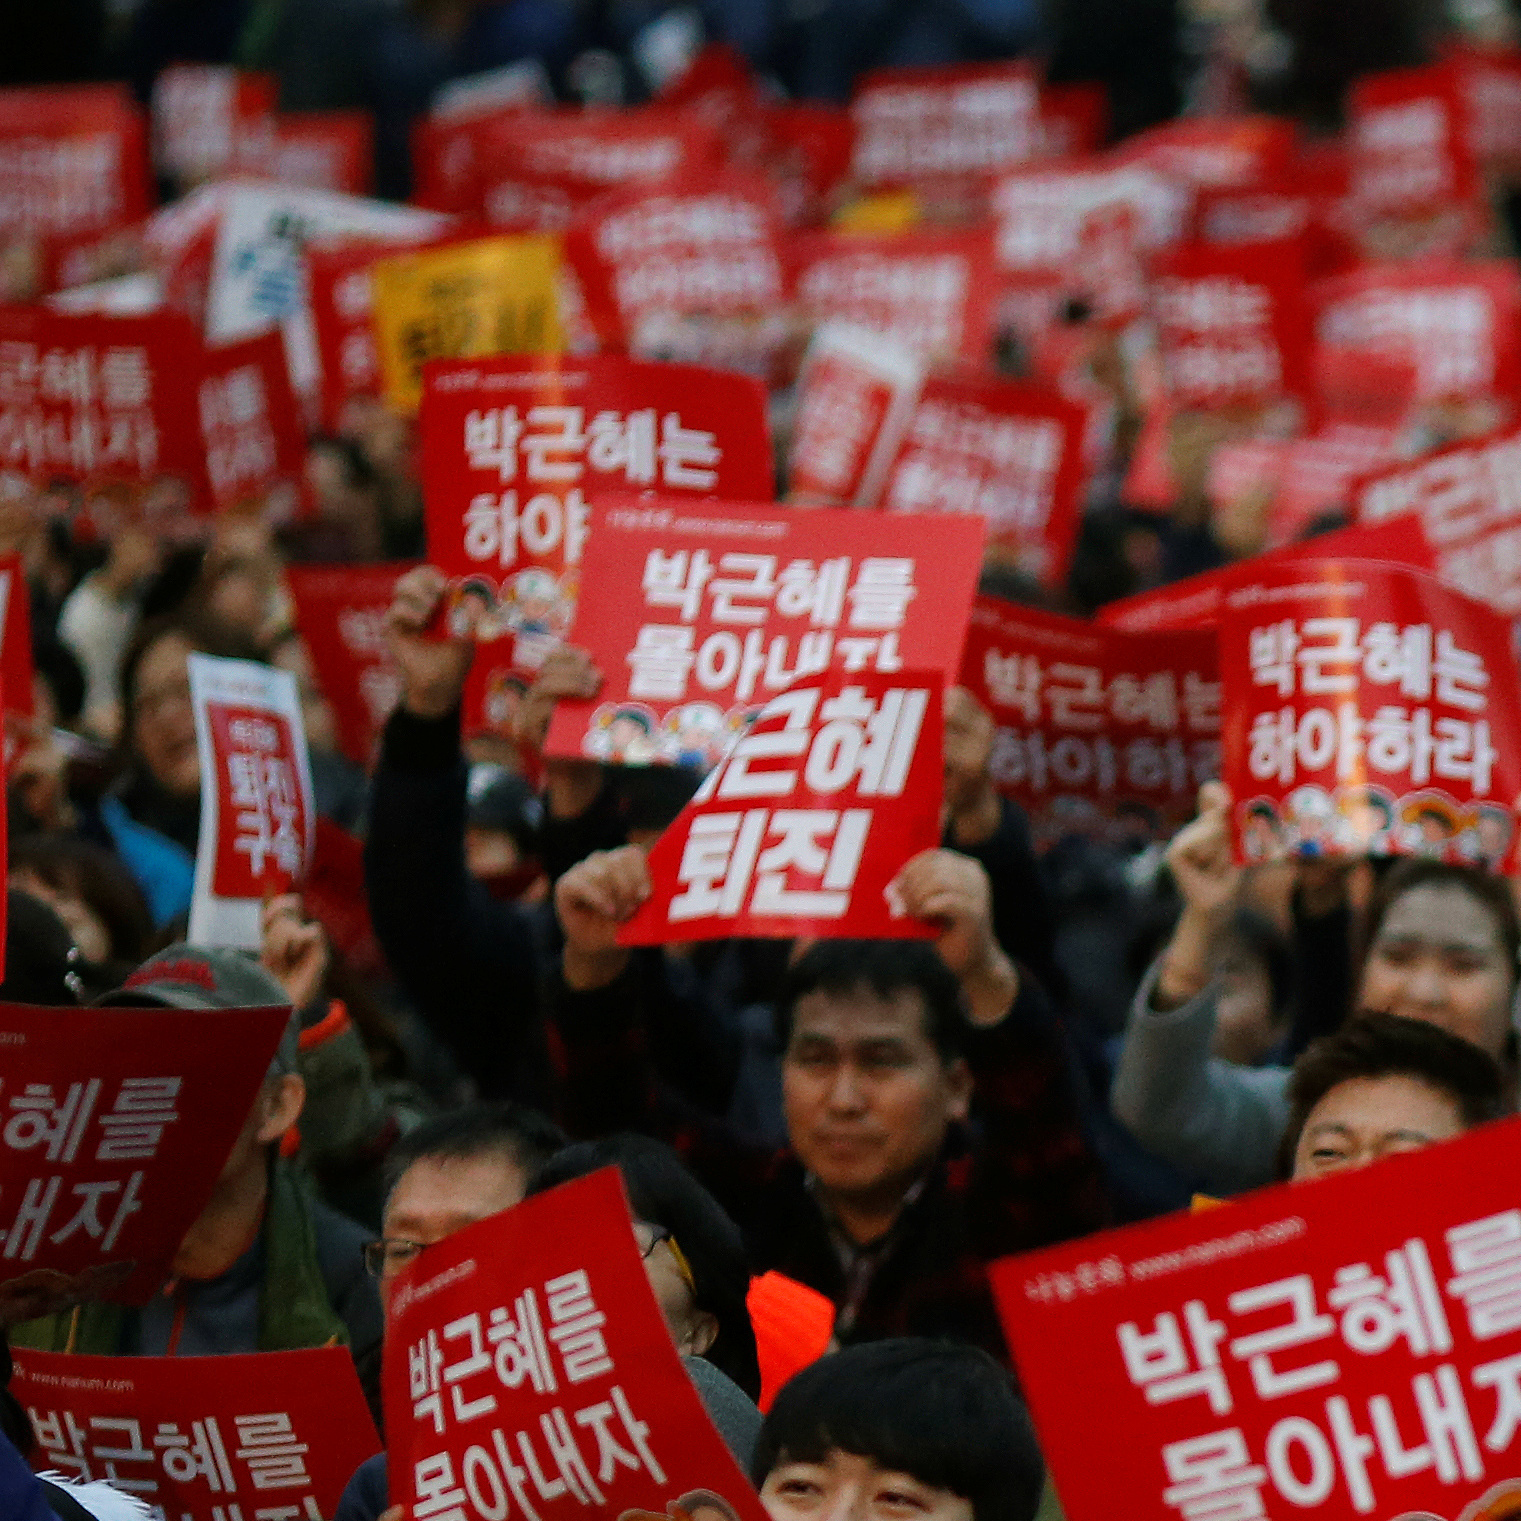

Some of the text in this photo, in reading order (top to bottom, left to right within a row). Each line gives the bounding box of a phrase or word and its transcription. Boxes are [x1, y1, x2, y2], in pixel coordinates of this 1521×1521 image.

[463, 405, 724, 490] 박근혜는
[462, 490, 591, 570] 하야
[642, 548, 917, 629] 박근혜를
[1248, 616, 1492, 713] 박근혜는
[690, 685, 931, 802] 근혜
[1247, 700, 1498, 798] 하야하라
[667, 806, 875, 923] 퇴진
[0, 1075, 183, 1164] 혜를
[408, 1268, 616, 1436] 박근혜를
[27, 1405, 312, 1494] 박근혜를
